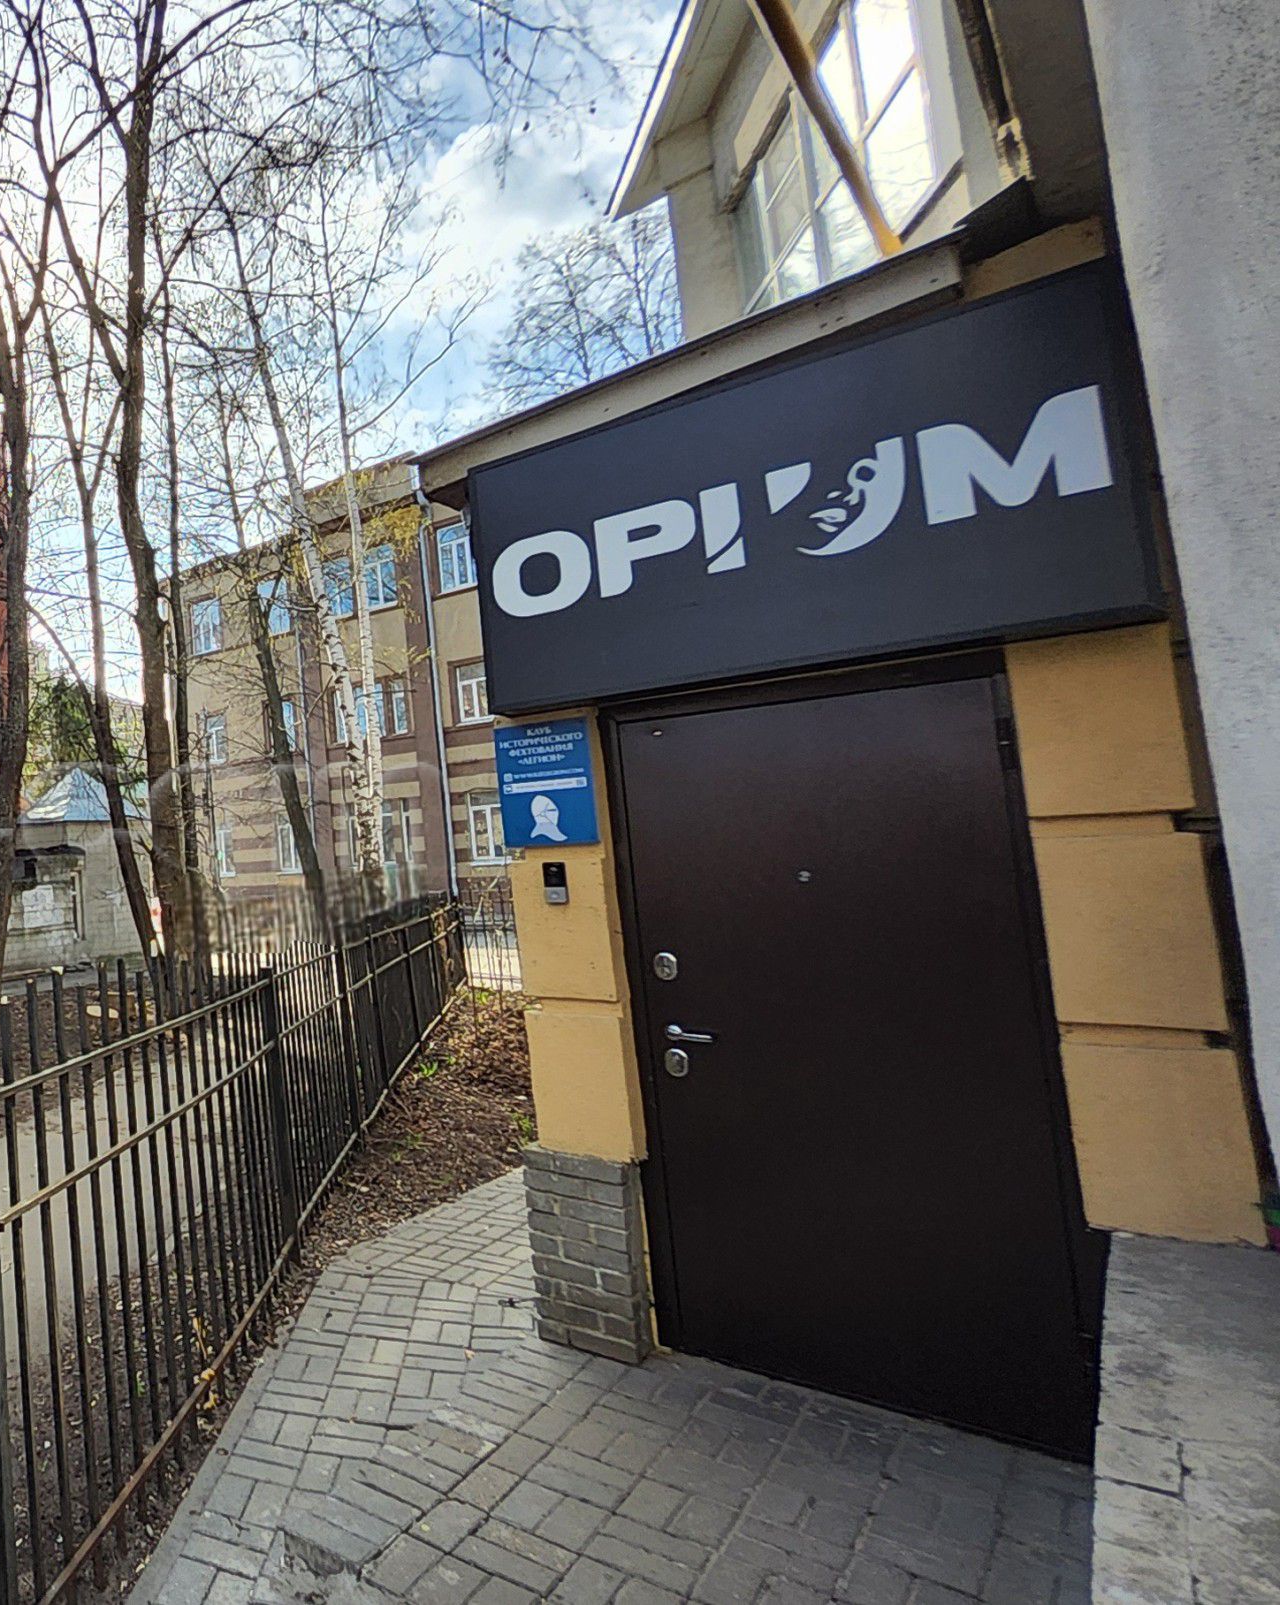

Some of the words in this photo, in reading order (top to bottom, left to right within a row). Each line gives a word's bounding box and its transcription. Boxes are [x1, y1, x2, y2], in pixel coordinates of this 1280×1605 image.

[492, 385, 1113, 617] OPIUM
[526, 726, 552, 737] КЛУБ
[499, 731, 583, 749] ИСТОРИЧЕСКОГО
[508, 742, 574, 757] ФЕХТОВАНИЯ
